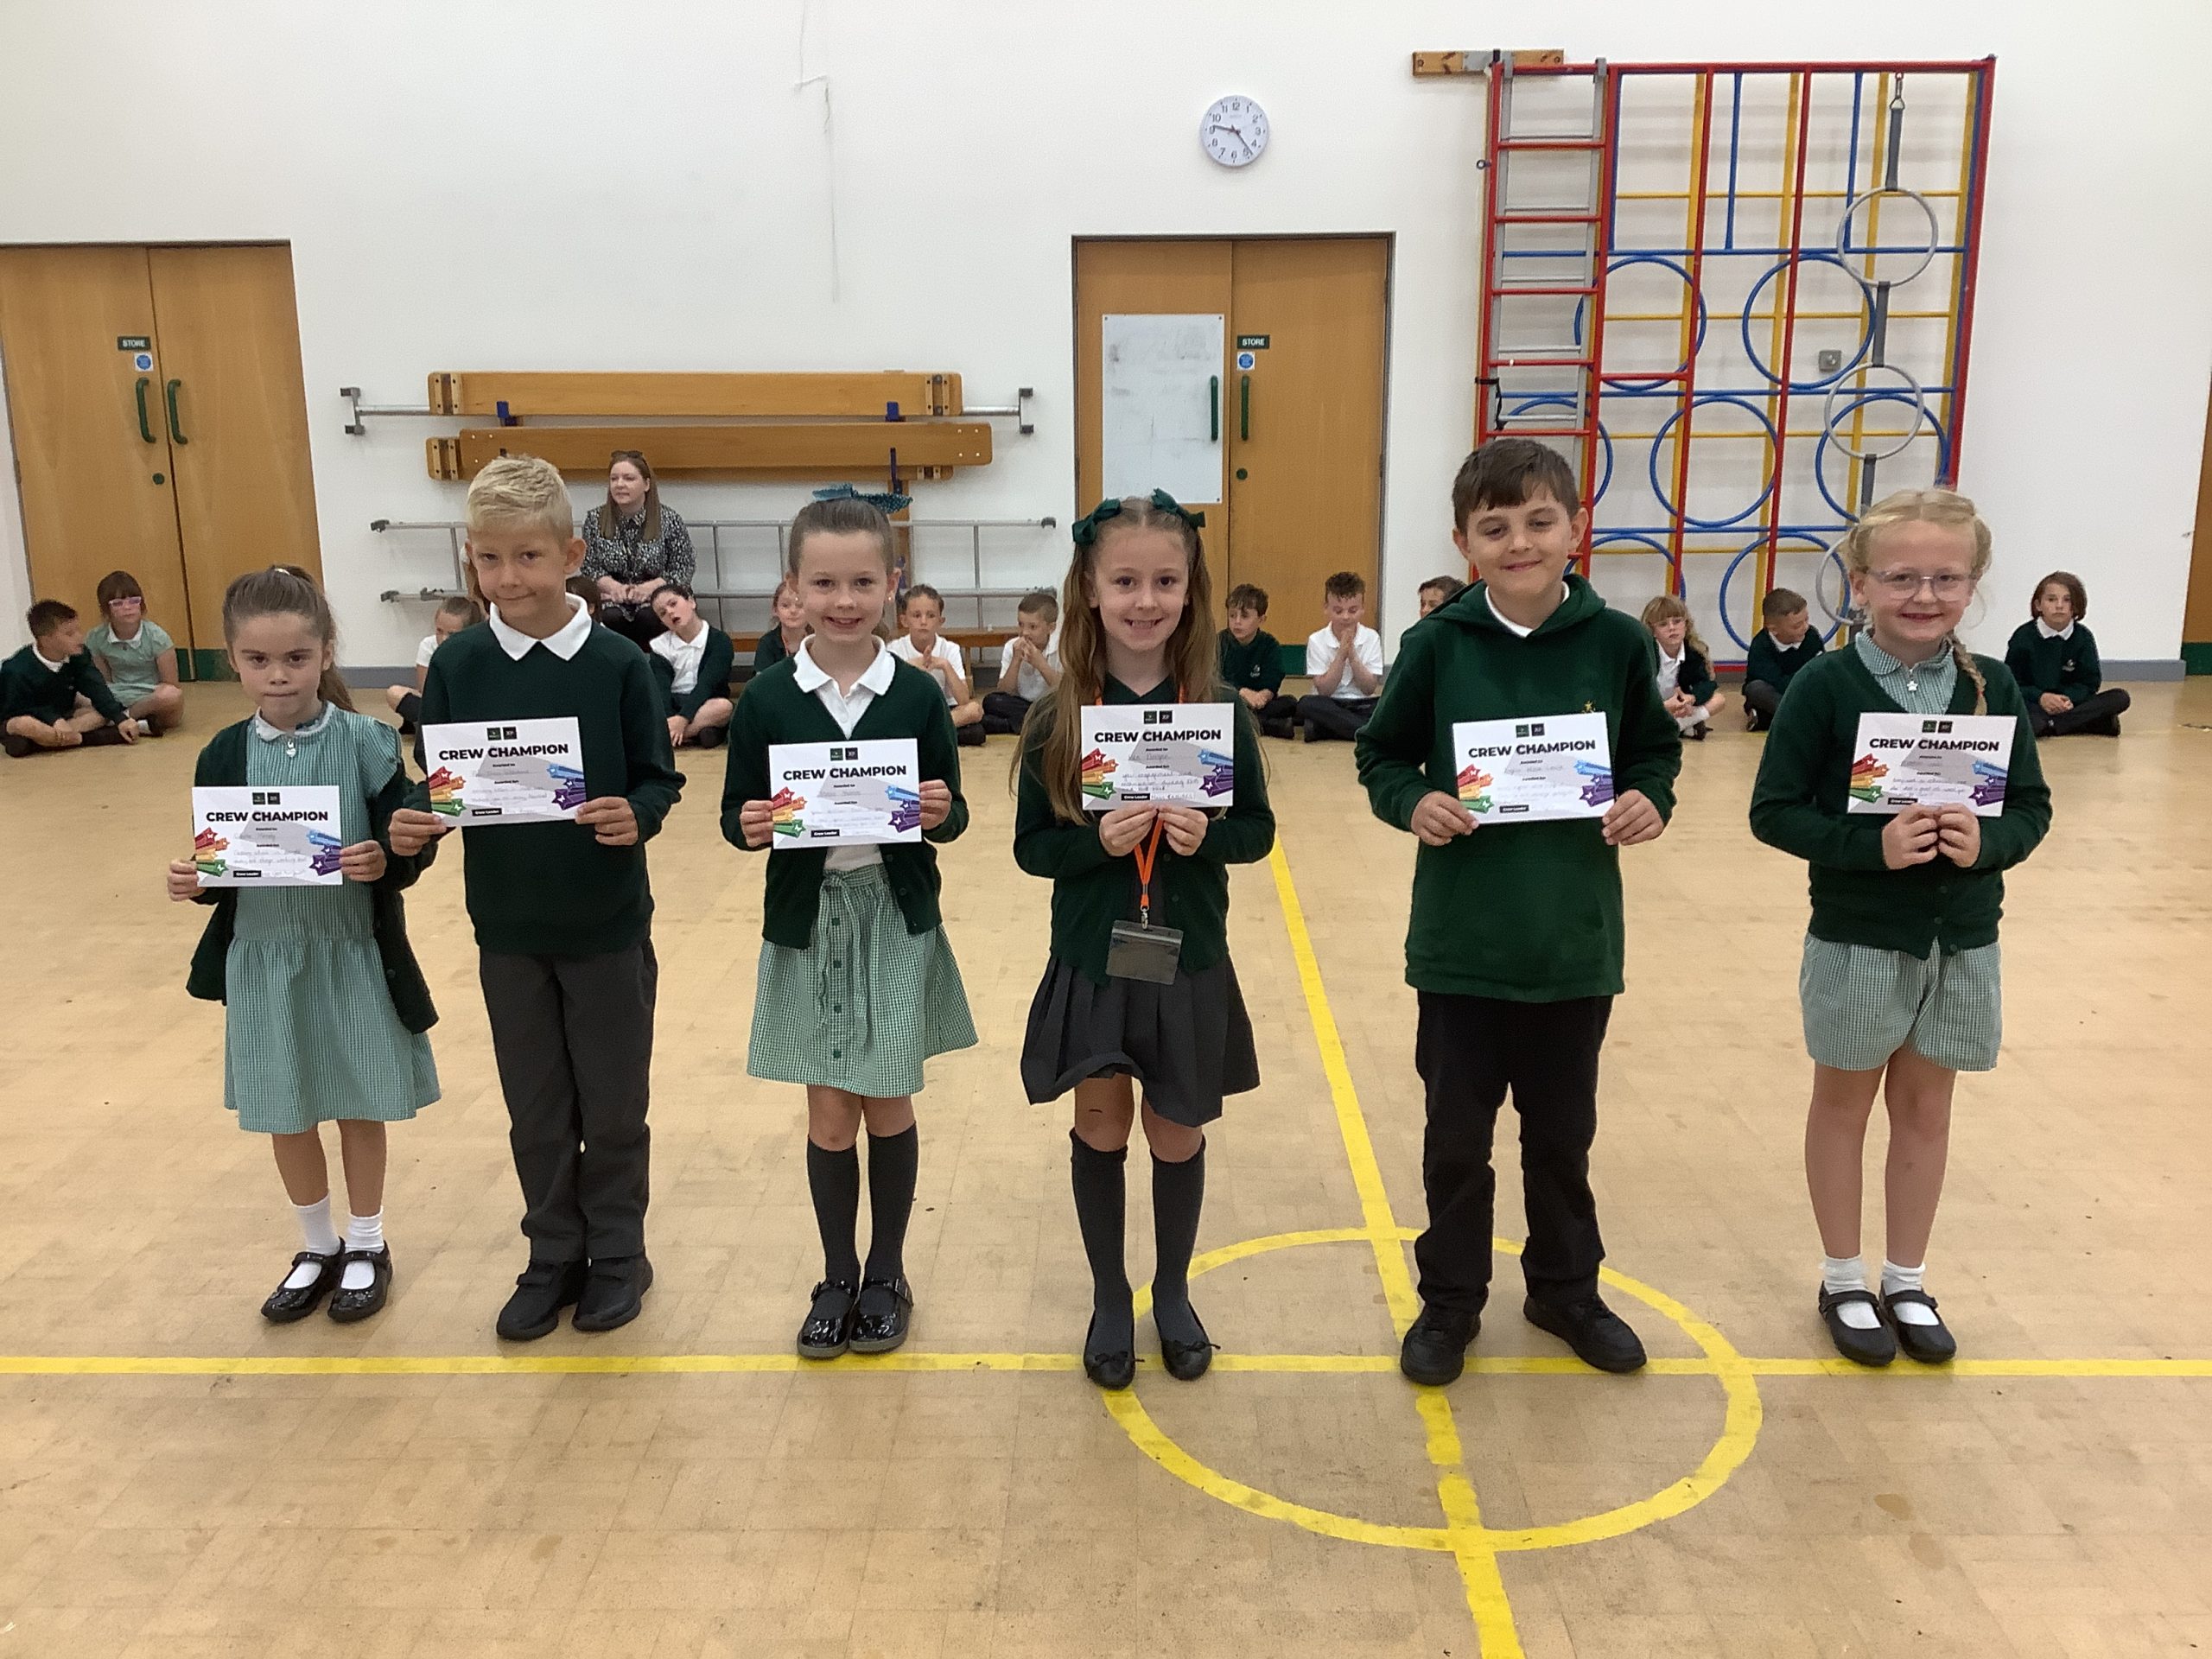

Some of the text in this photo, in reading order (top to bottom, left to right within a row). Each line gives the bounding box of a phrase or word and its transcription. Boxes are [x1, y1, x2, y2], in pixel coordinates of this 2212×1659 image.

[1222, 105, 1228, 113] 11
[1232, 102, 1240, 111] 12
[1212, 114, 1221, 123] 10
[1252, 114, 1259, 123] 2
[1255, 127, 1261, 136] 3
[1212, 138, 1218, 146] 8
[1220, 147, 1226, 156] 7
[1231, 150, 1237, 159] 6
[123, 340, 146, 348] STORE
[1243, 338, 1265, 346] STORE
[1095, 730, 1221, 742] CREW CHAMPION
[1469, 740, 1596, 758] CREW CHAMPION
[1870, 739, 2000, 751] CREW CHAMPION
[439, 744, 569, 760] CREW CHAMPION
[783, 766, 906, 781] CREW CHAMPION
[206, 811, 328, 821] CREW CHAMPION
